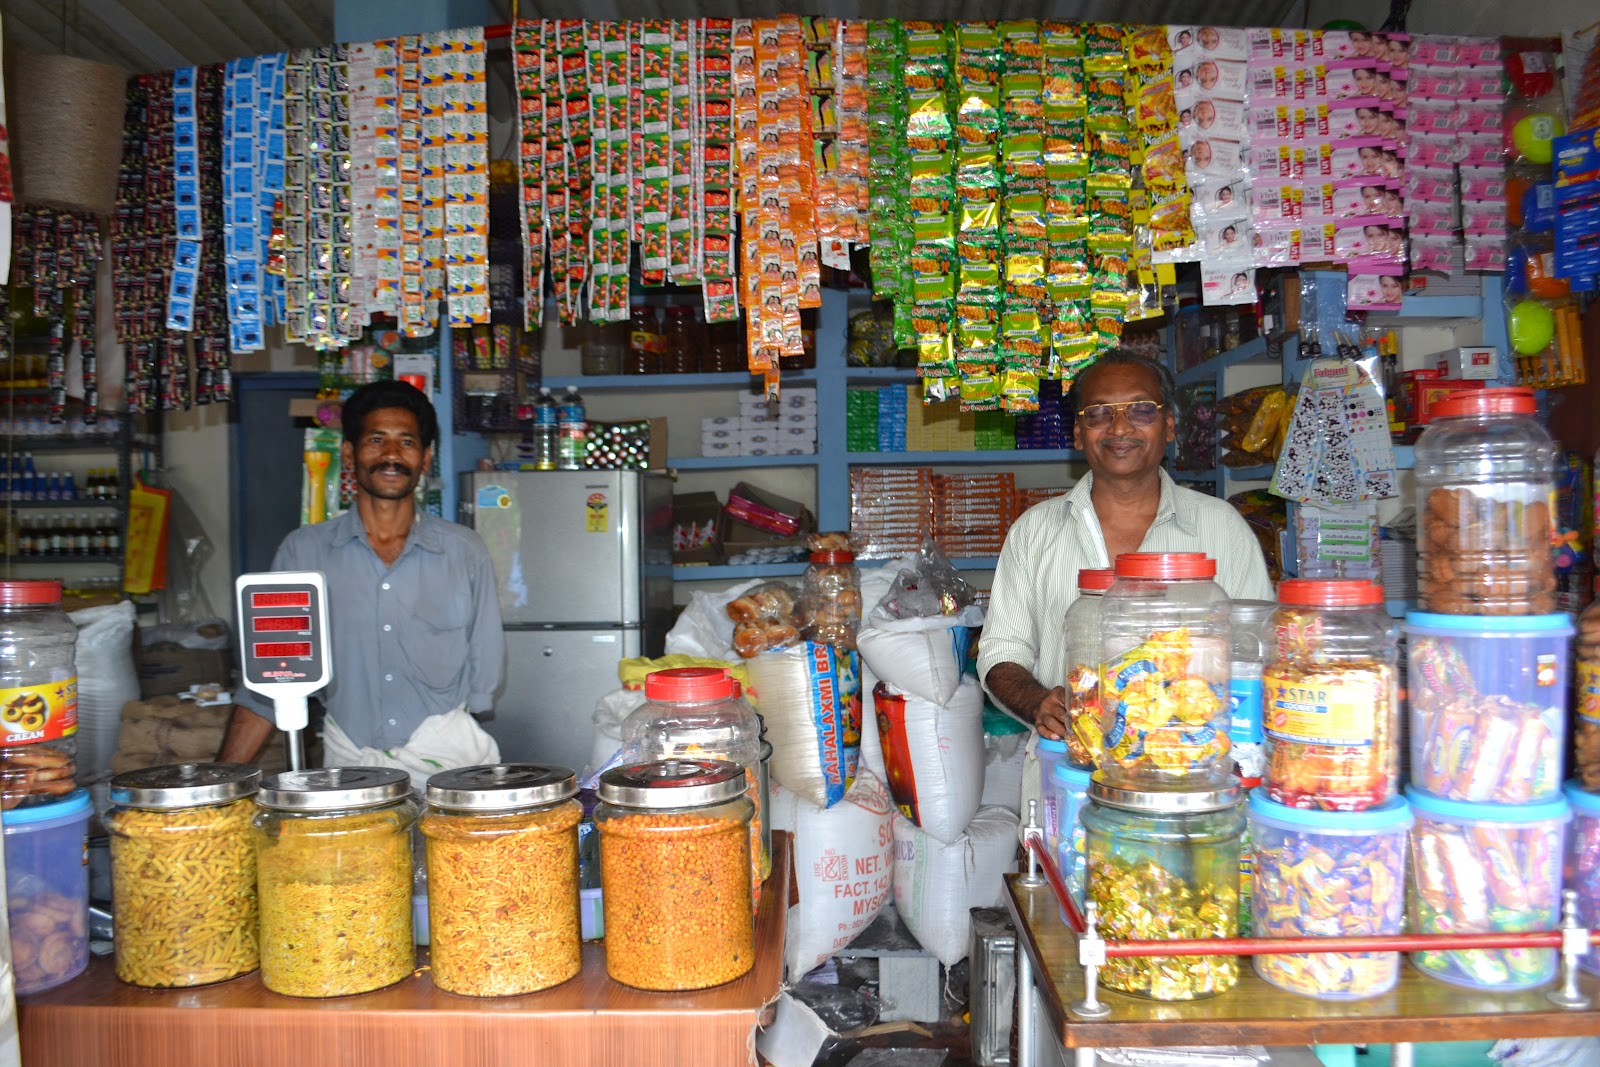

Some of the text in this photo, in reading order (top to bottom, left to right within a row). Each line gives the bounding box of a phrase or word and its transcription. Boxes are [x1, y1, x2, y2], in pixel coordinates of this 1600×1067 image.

[1273, 43, 1280, 51] 5
[1313, 42, 1320, 50] 5
[1296, 47, 1303, 55] 5
[1046, 63, 1081, 76] Ringo
[1276, 82, 1283, 91] 5
[1317, 81, 1324, 89] 5
[1296, 86, 1303, 94] 5
[1278, 122, 1285, 131] 5
[1295, 125, 1302, 134] 5
[1319, 121, 1327, 129] 5
[1045, 126, 1081, 137] Ringo
[1280, 162, 1287, 171] 5
[1294, 165, 1301, 174] 5
[1321, 161, 1328, 170] 5
[1046, 186, 1083, 198] Ringo
[1282, 202, 1289, 212] 5
[1323, 200, 1331, 209] 5
[1293, 205, 1300, 214] 5
[957, 232, 995, 244] Ringo
[1325, 240, 1332, 249] 5
[1048, 247, 1084, 259] Ringo
[1291, 246, 1298, 255] 5
[912, 306, 947, 318] Ringo
[957, 351, 994, 362] Ringo
[916, 367, 950, 378] Ringo
[1288, 688, 1327, 704] STAR
[6, 730, 45, 743] CREAM
[894, 840, 915, 862] ICE
[813, 861, 821, 877] USE
[840, 854, 848, 881] HOOKS
[855, 855, 881, 876] NET.
[834, 881, 871, 898] FACT.
